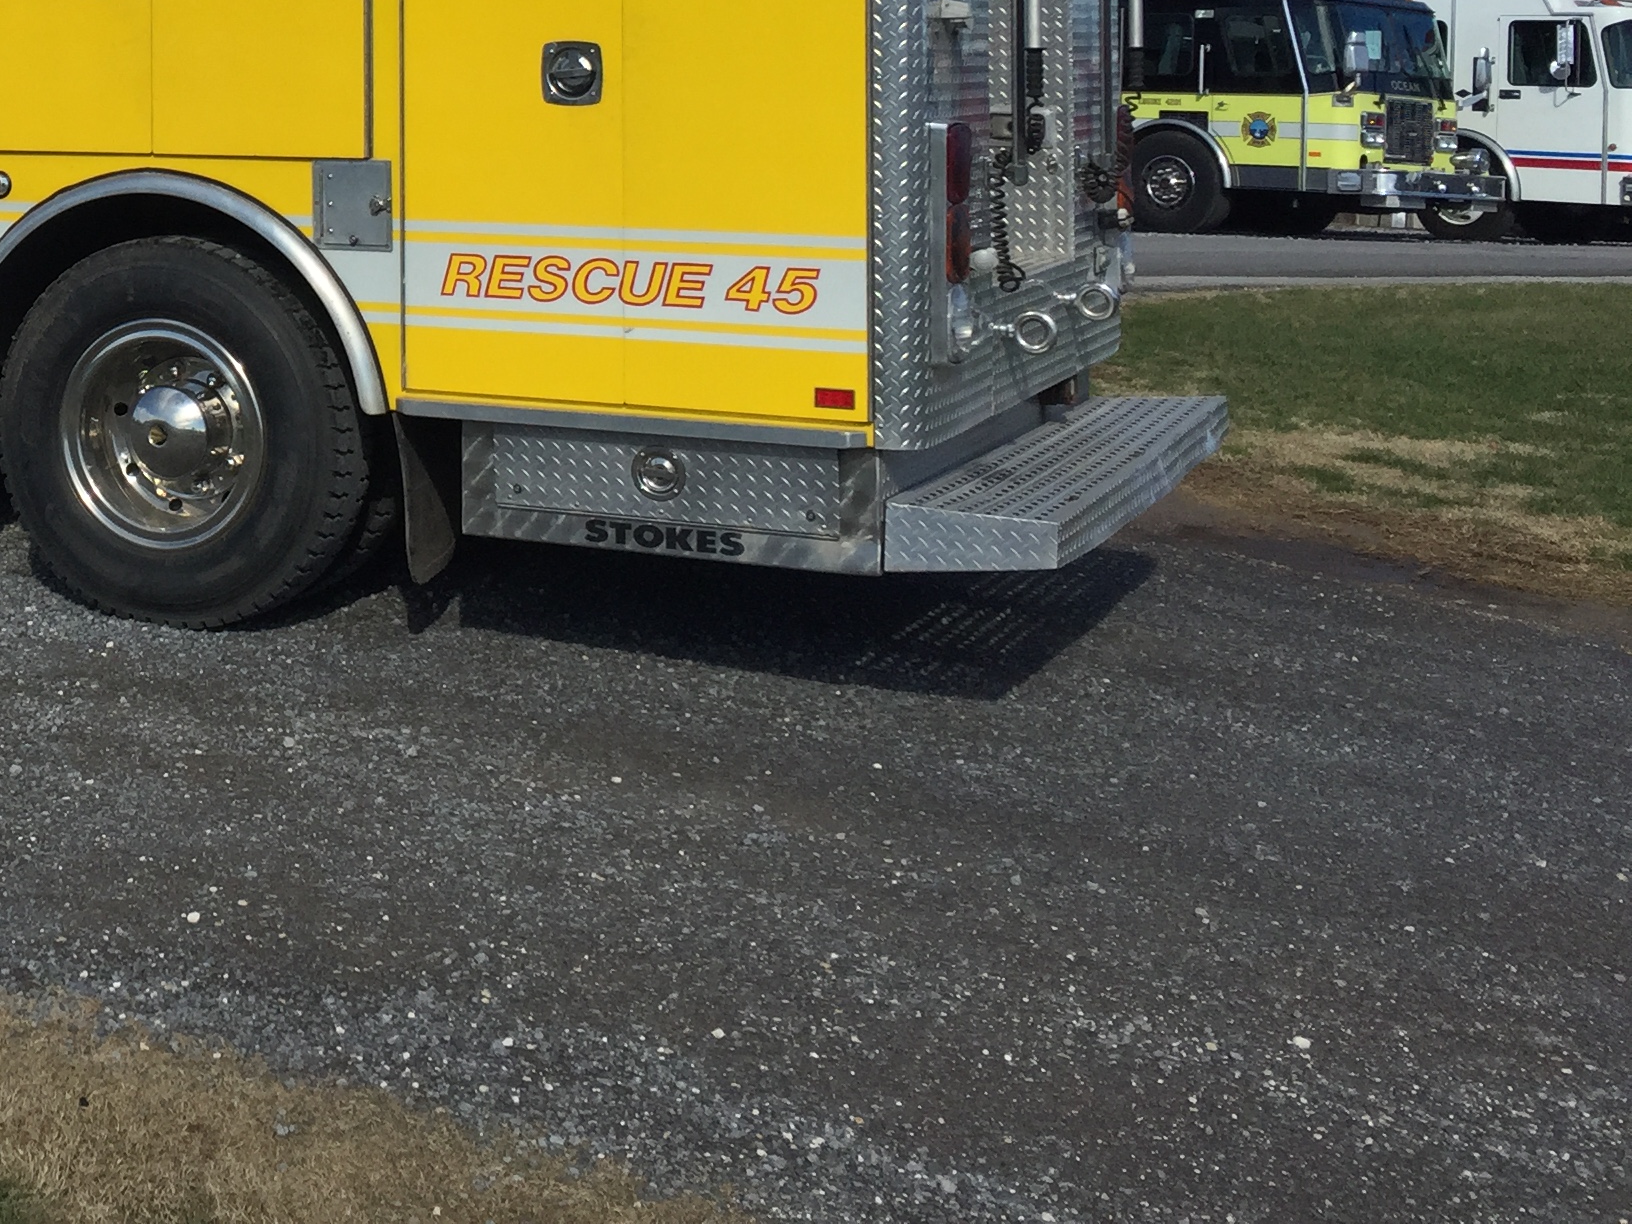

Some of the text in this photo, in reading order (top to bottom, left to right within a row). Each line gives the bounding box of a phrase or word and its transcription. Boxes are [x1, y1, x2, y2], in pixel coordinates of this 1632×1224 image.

[1390, 80, 1421, 92] OCEAN
[441, 253, 821, 314] RESCUE 45
[584, 519, 745, 556] STOKES
